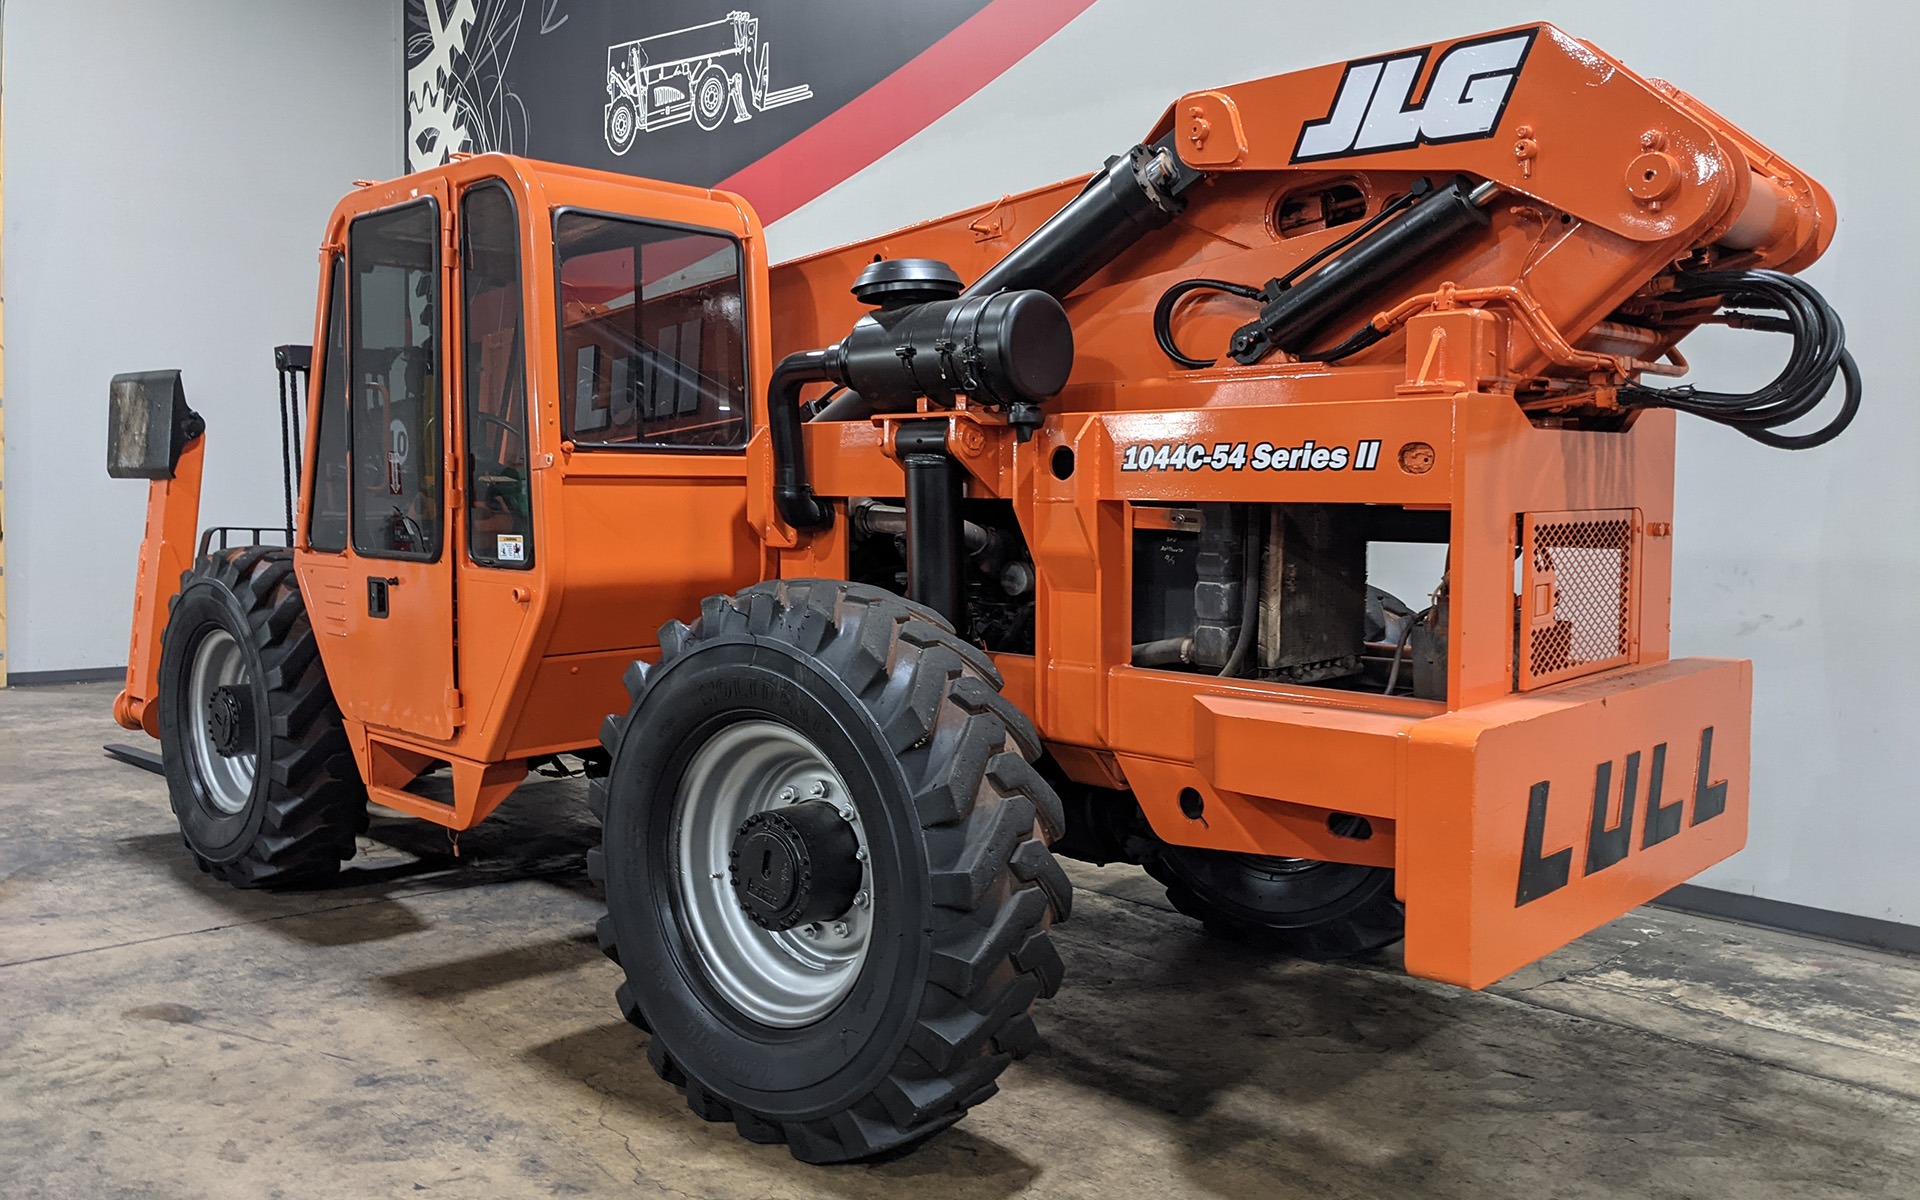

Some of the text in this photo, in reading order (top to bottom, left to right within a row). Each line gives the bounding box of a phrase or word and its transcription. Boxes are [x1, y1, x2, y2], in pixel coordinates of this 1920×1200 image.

[1289, 27, 1540, 164] JLG
[1122, 443, 1249, 471] 1044C-54
[1250, 441, 1348, 471] Series
[1515, 726, 1728, 908] LULL
